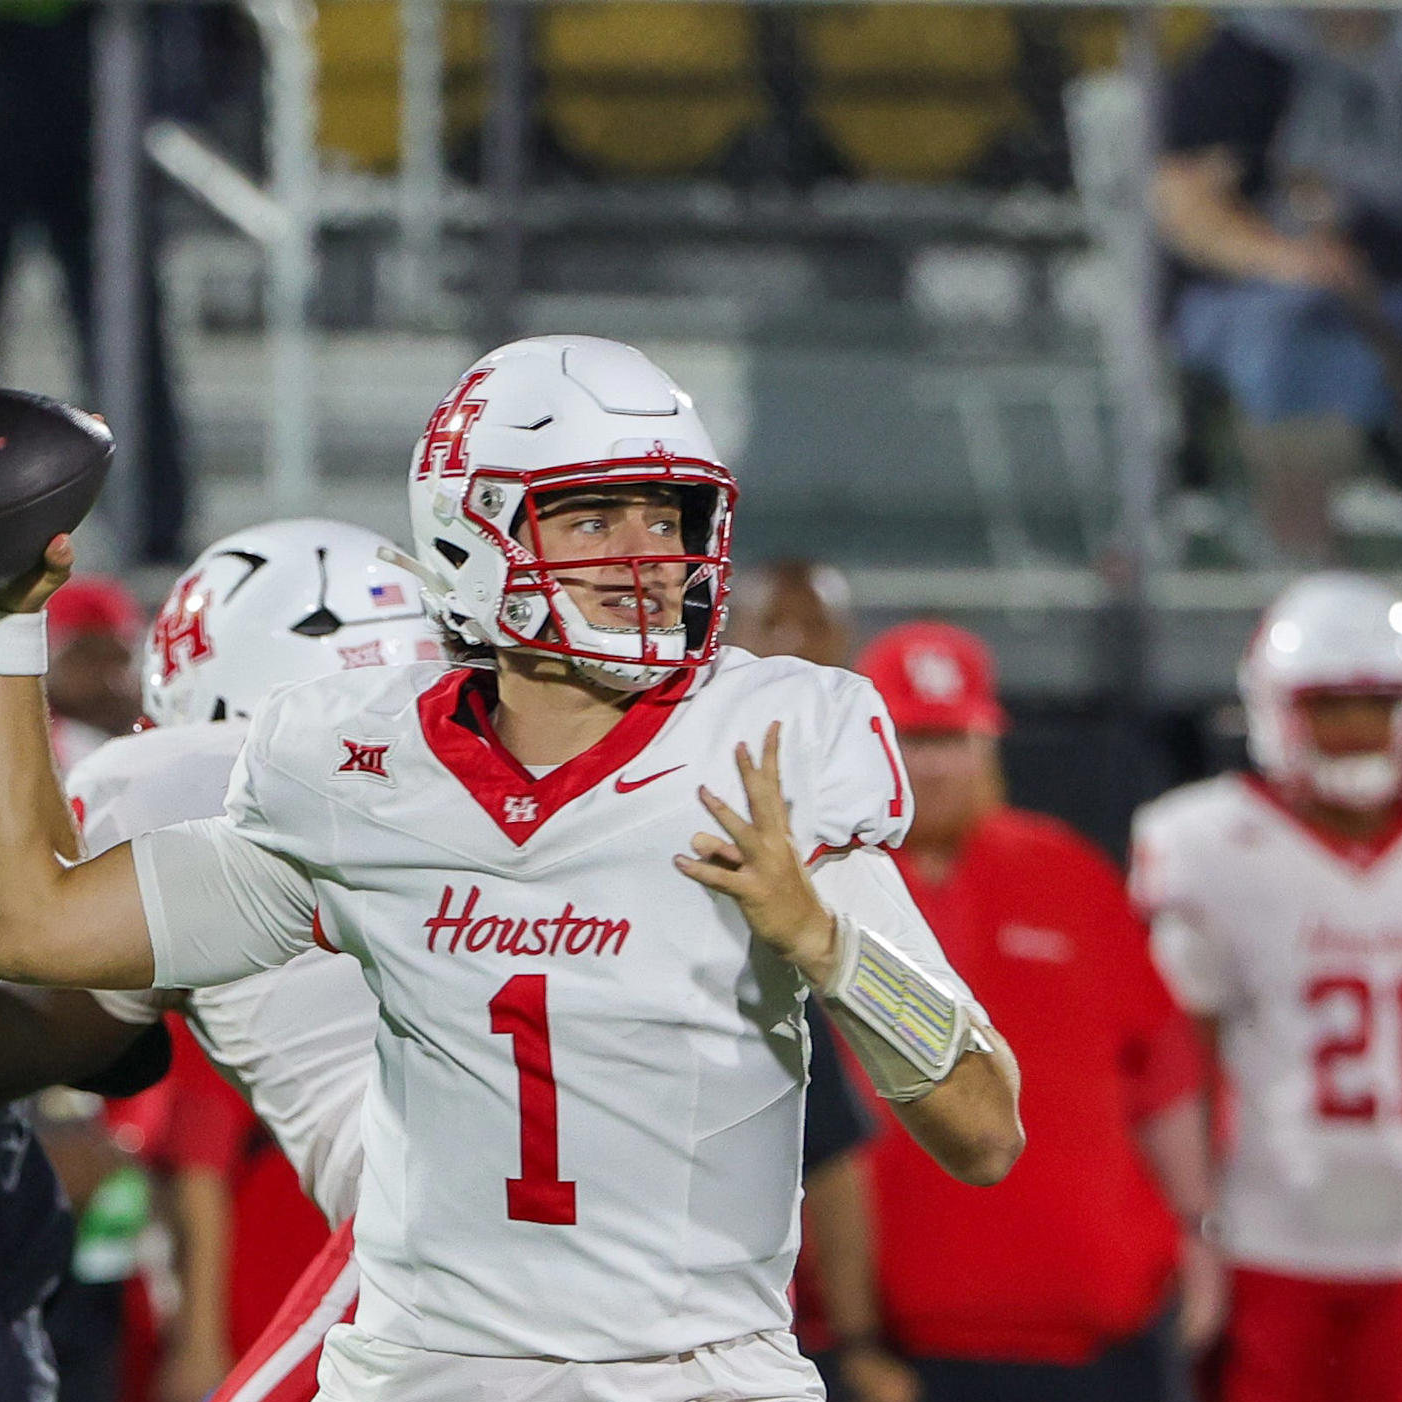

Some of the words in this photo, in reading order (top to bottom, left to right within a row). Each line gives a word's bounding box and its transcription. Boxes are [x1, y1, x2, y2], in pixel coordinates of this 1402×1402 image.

[338, 739, 391, 778] XII
[870, 716, 902, 817] 1
[425, 886, 630, 956] Houston
[489, 974, 577, 1226] 1
